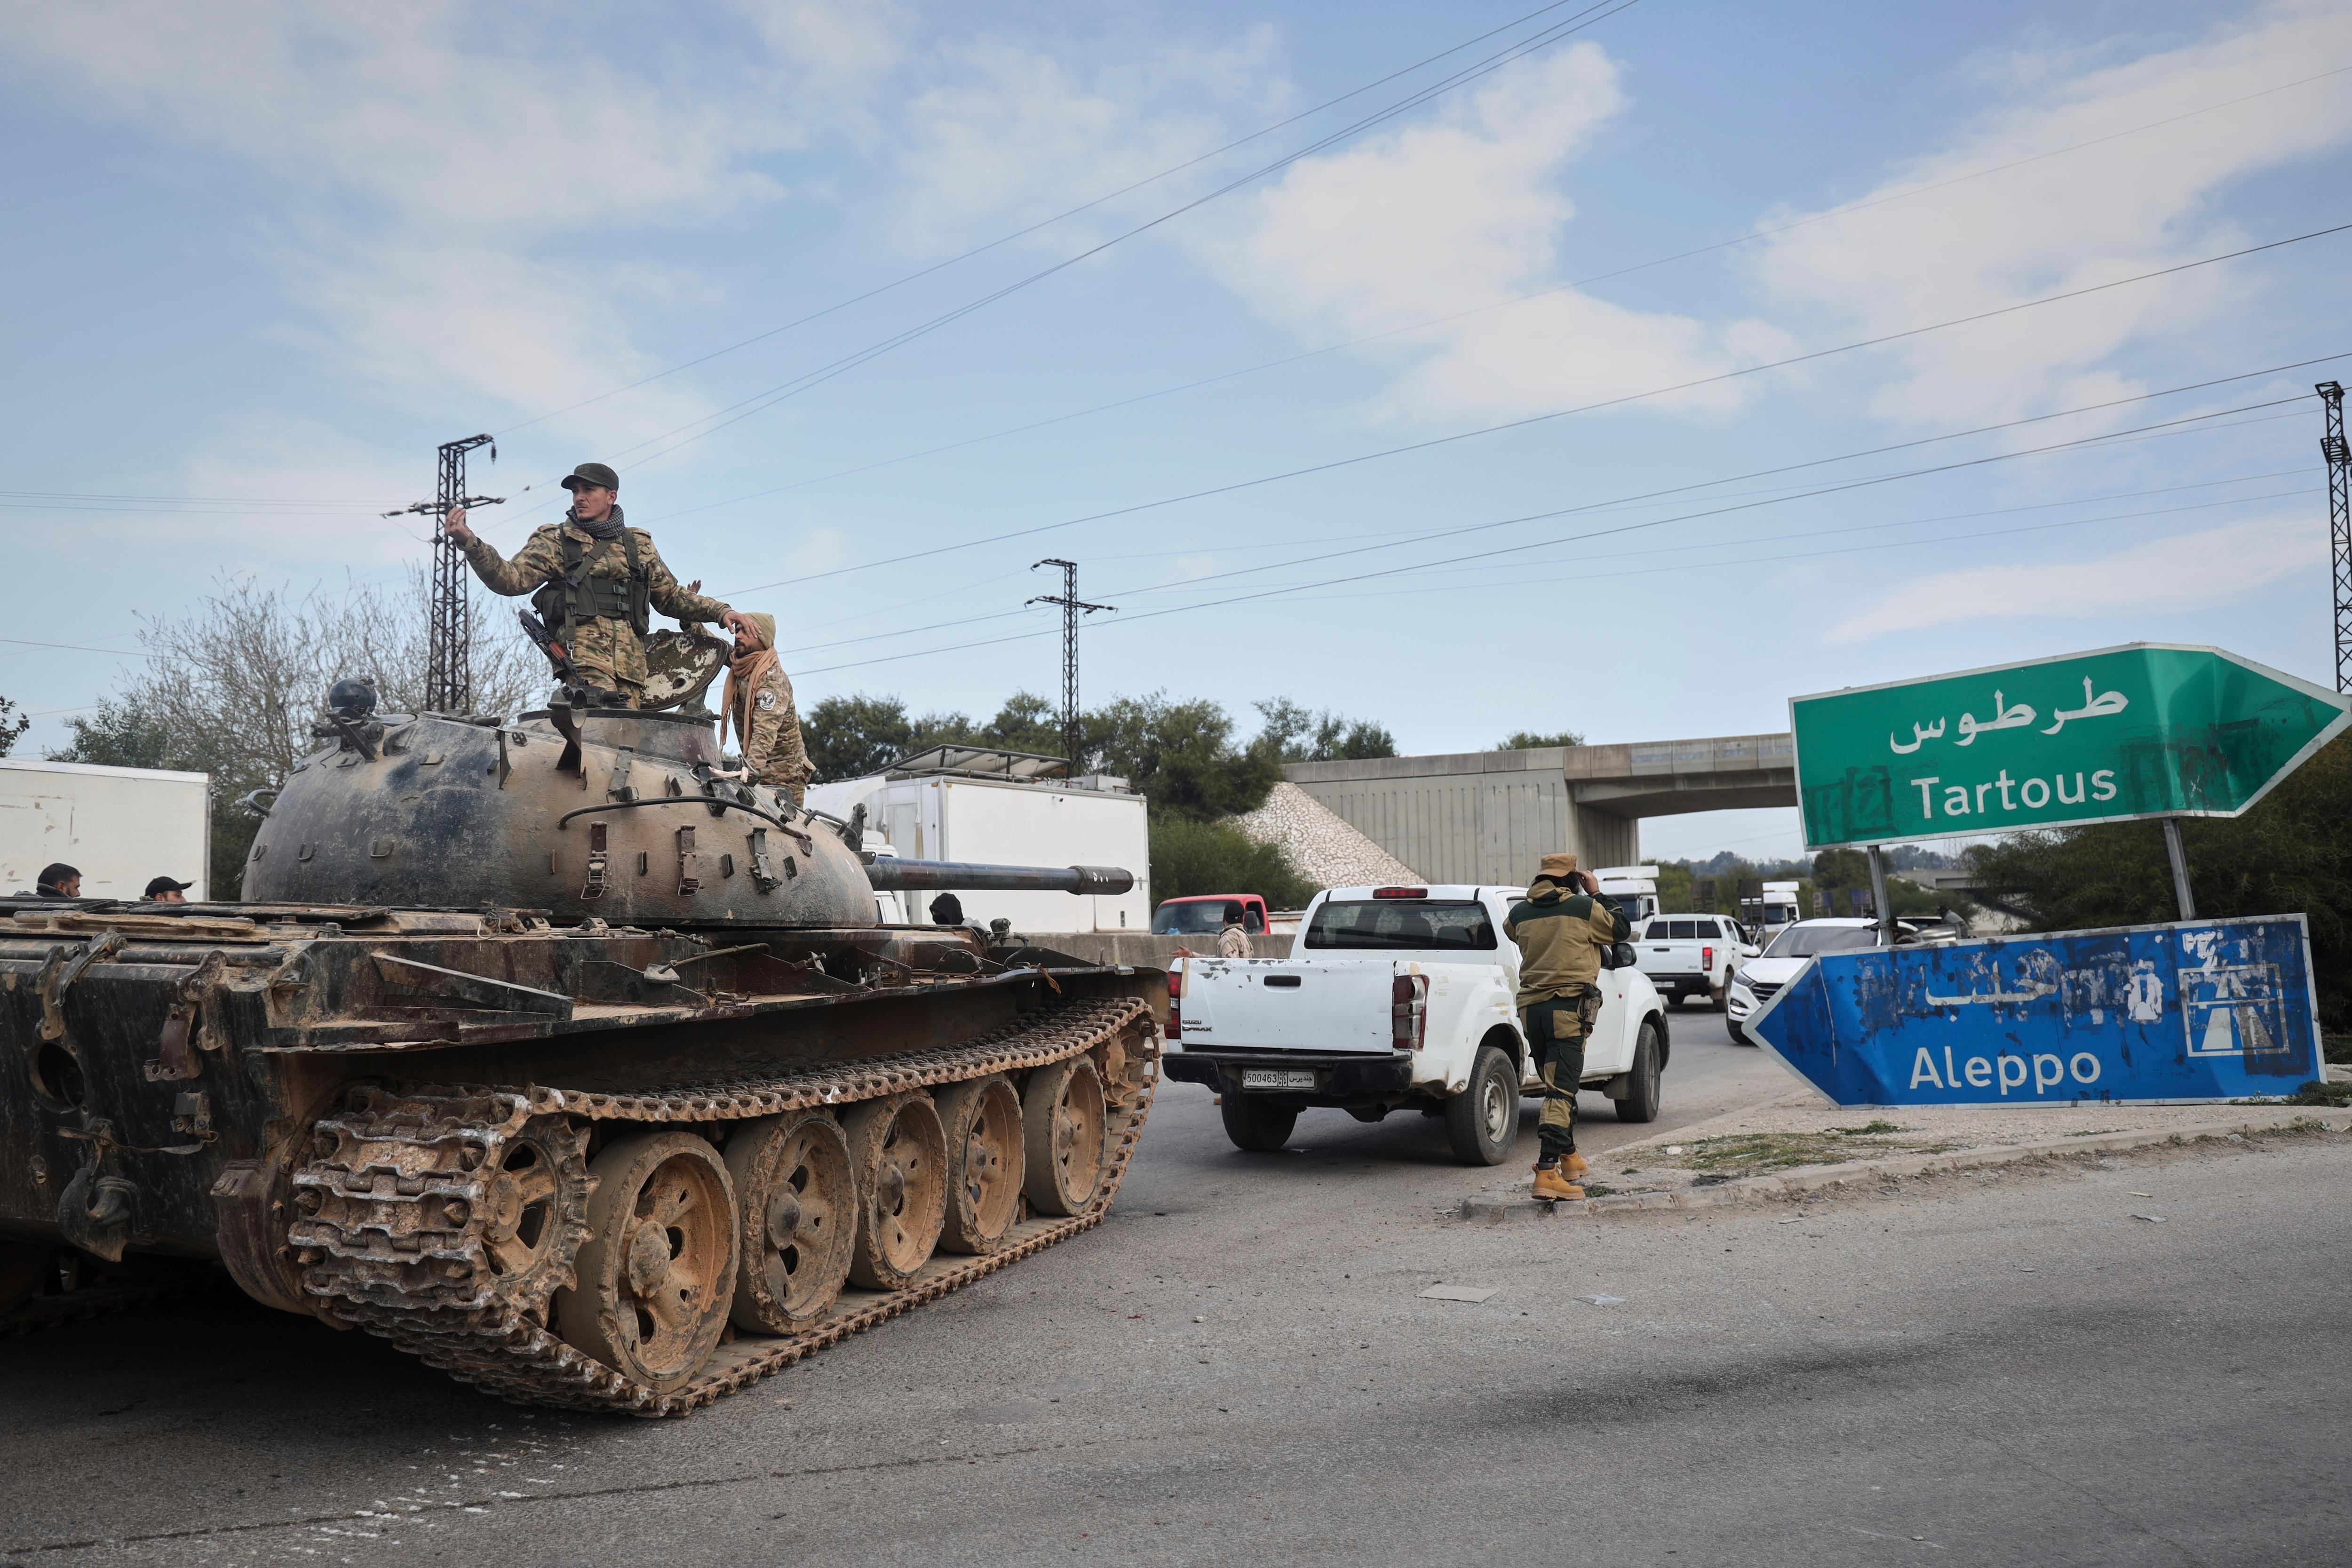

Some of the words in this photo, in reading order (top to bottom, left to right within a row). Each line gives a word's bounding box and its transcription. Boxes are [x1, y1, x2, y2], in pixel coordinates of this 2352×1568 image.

[1890, 675, 2129, 754] طرطوس
[1910, 768, 2117, 819] Tartous
[1925, 960, 2058, 1022] حلب
[1247, 1074, 1277, 1083] 500463
[1289, 1075, 1312, 1083] جنديرس
[1909, 1046, 2101, 1095] Aleppo
